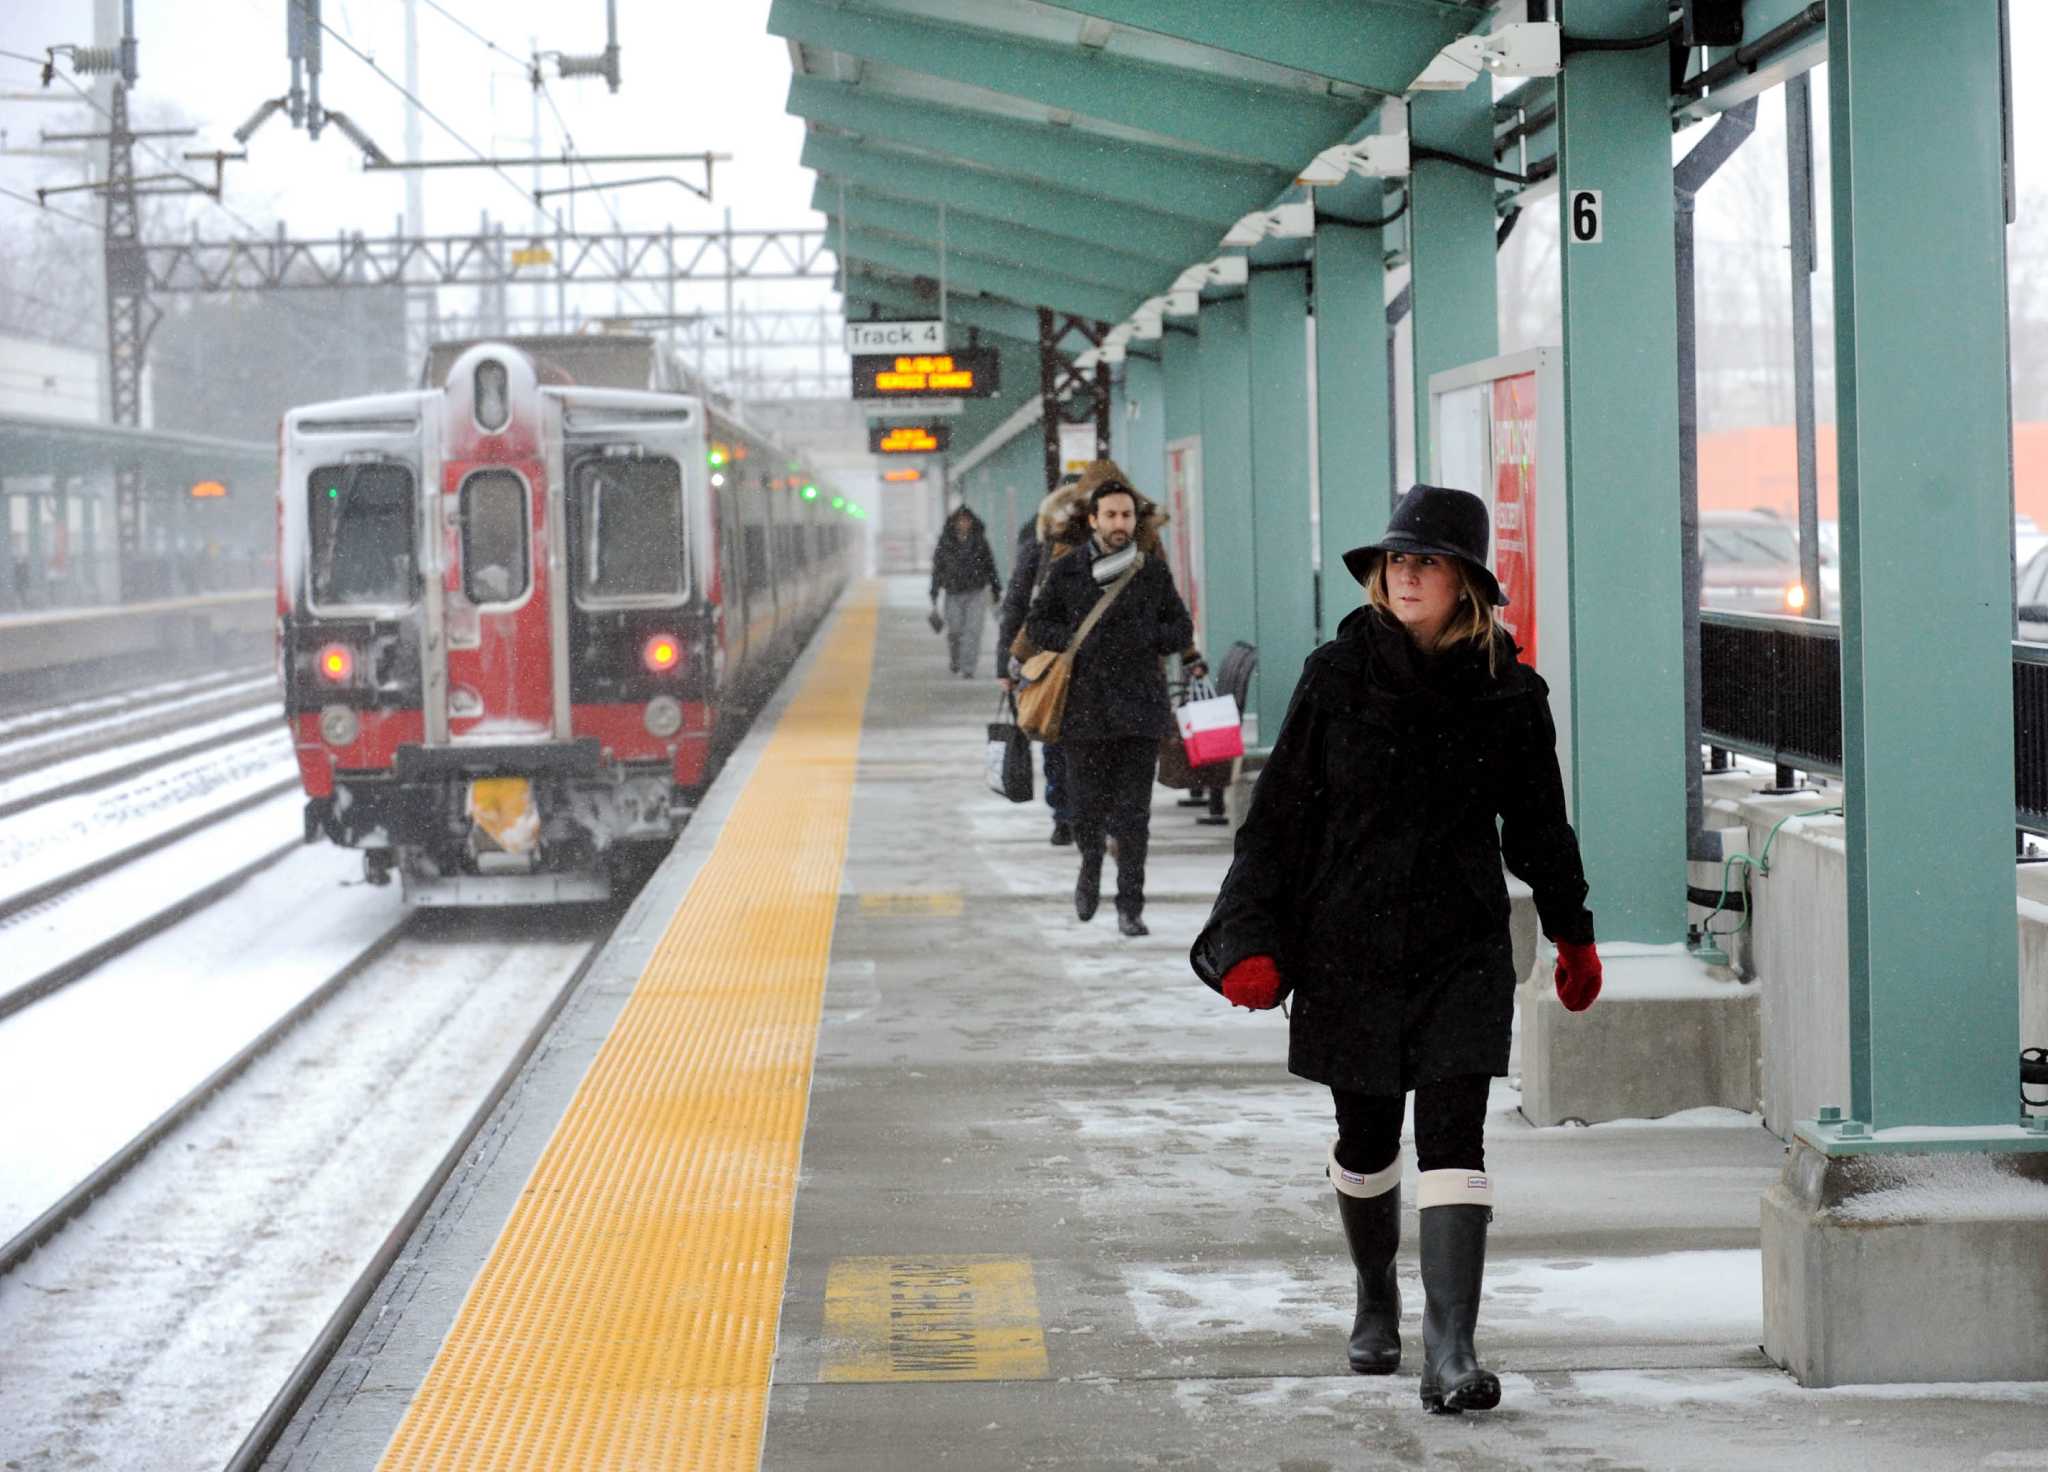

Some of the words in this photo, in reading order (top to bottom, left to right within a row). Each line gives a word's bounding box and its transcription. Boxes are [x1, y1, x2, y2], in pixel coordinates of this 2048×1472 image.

[1574, 192, 1597, 241] 6
[850, 326, 912, 344] Track
[924, 325, 937, 341] 4
[889, 1264, 972, 1291] GAP
[890, 1291, 976, 1321] THE
[890, 1322, 977, 1372] WATCH
